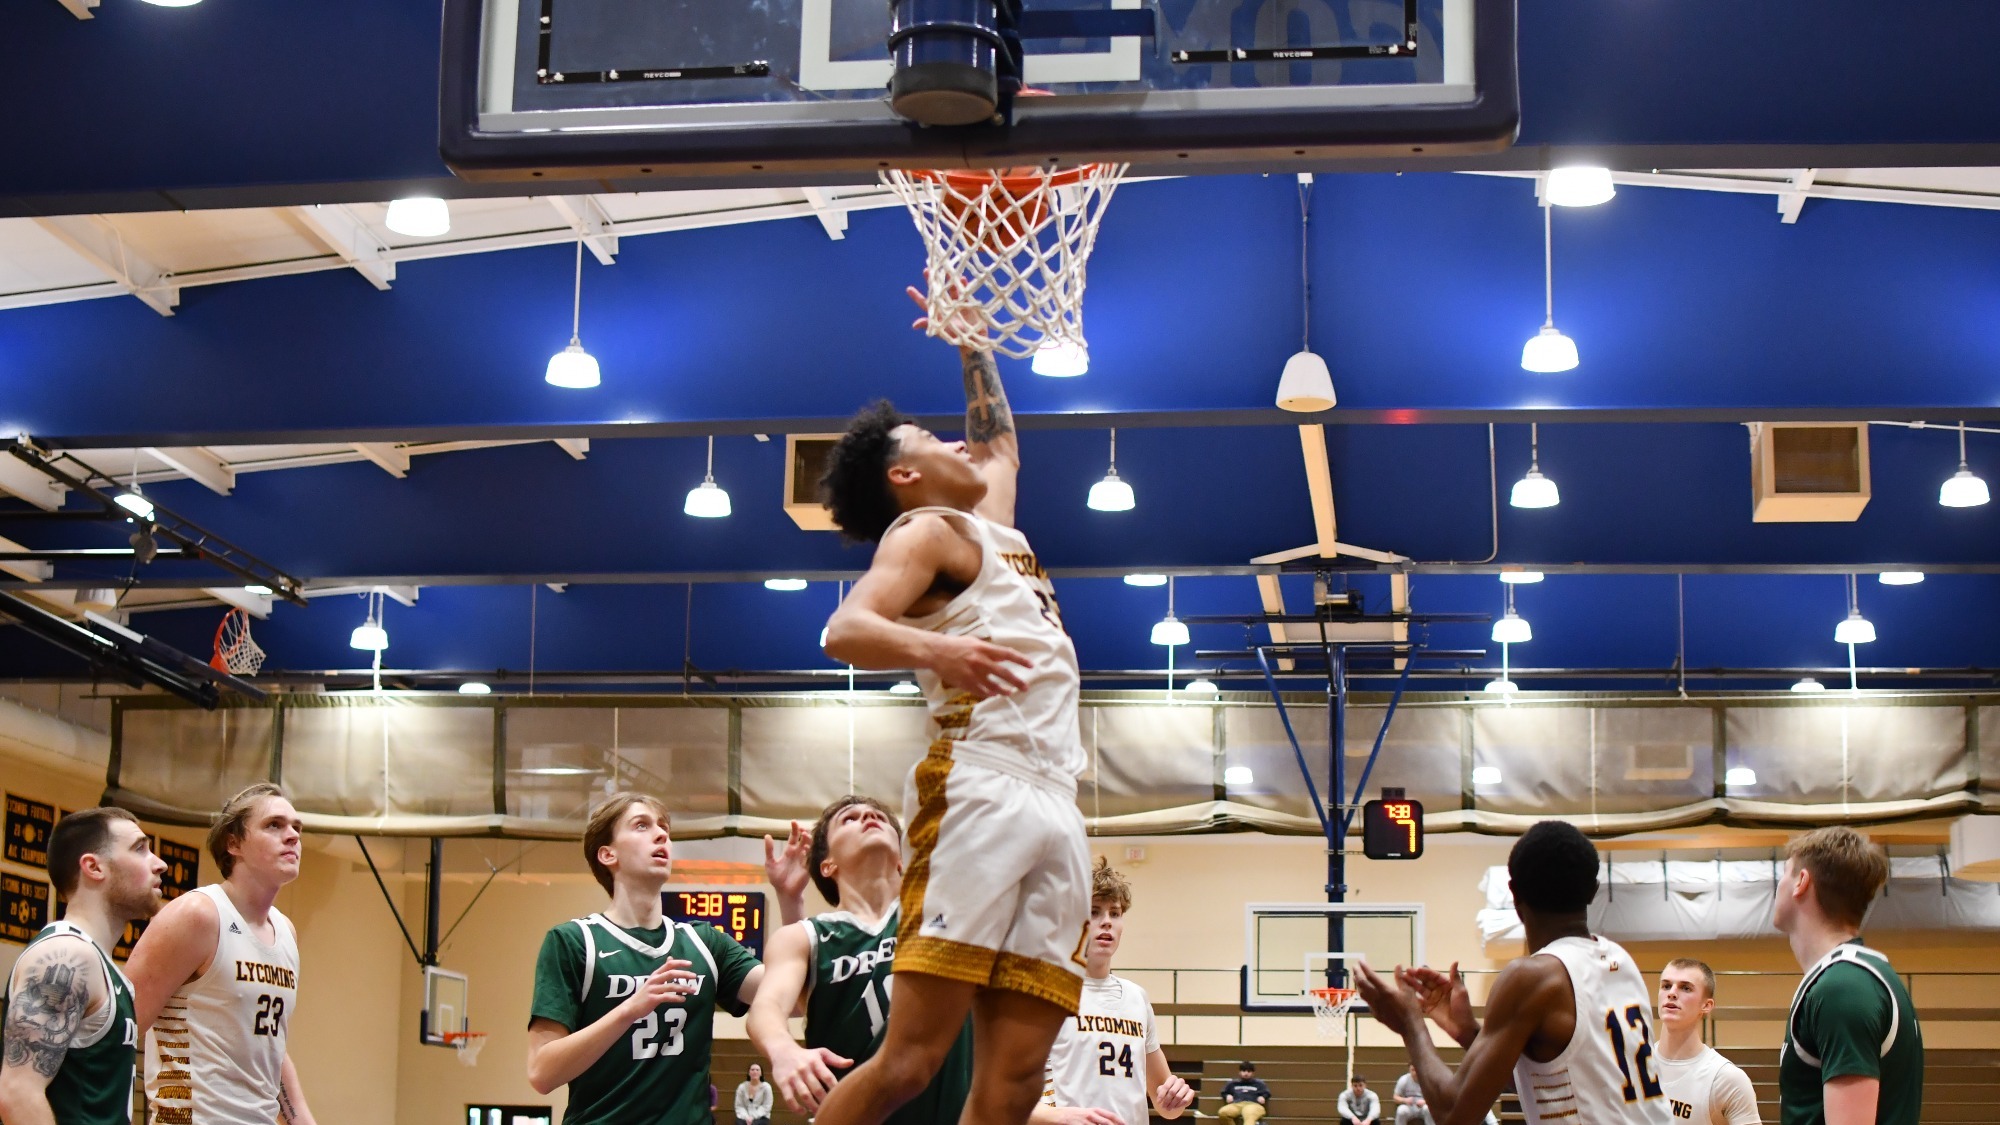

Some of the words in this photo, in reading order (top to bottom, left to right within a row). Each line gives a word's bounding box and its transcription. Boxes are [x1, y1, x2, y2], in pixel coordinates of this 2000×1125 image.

[1384, 804, 1411, 818] 7:38
[1396, 819, 1416, 853] 7
[679, 893, 723, 917] 7:38
[732, 907, 760, 931] 61
[235, 960, 296, 990] LYCOMING
[253, 993, 285, 1038] 23
[1075, 1015, 1145, 1039] LYCOMING
[631, 1007, 688, 1060] 23
[1098, 1041, 1134, 1079] 24
[1605, 1004, 1664, 1104] 12
